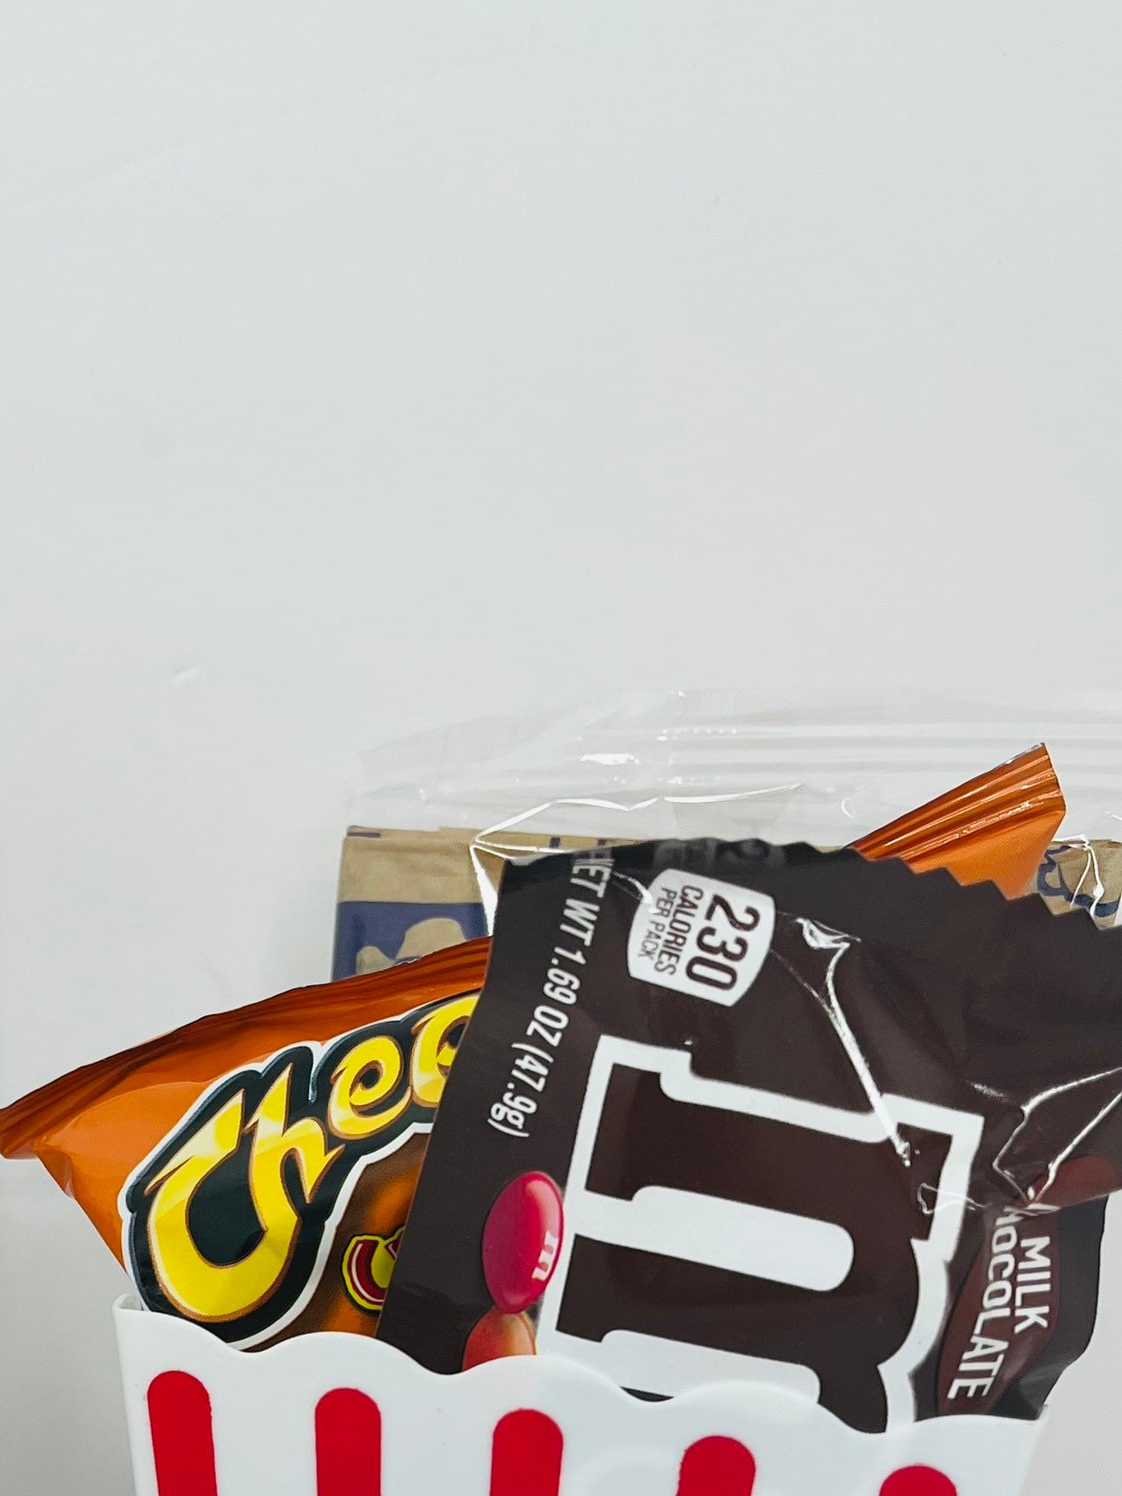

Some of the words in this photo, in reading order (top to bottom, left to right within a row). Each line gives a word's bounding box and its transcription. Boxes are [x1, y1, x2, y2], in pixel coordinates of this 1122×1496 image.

[559, 897, 600, 947] WT
[654, 886, 678, 918] PER
[654, 884, 704, 976] CALORIES
[543, 946, 586, 1005] 1.69
[637, 919, 666, 961] PACK
[685, 894, 760, 991] 230
[526, 1004, 569, 1047] OZ
[487, 1043, 554, 1138] (47.9g)
[946, 1207, 1023, 1400] HOCOLATE
[1014, 1235, 1051, 1334] MILK
